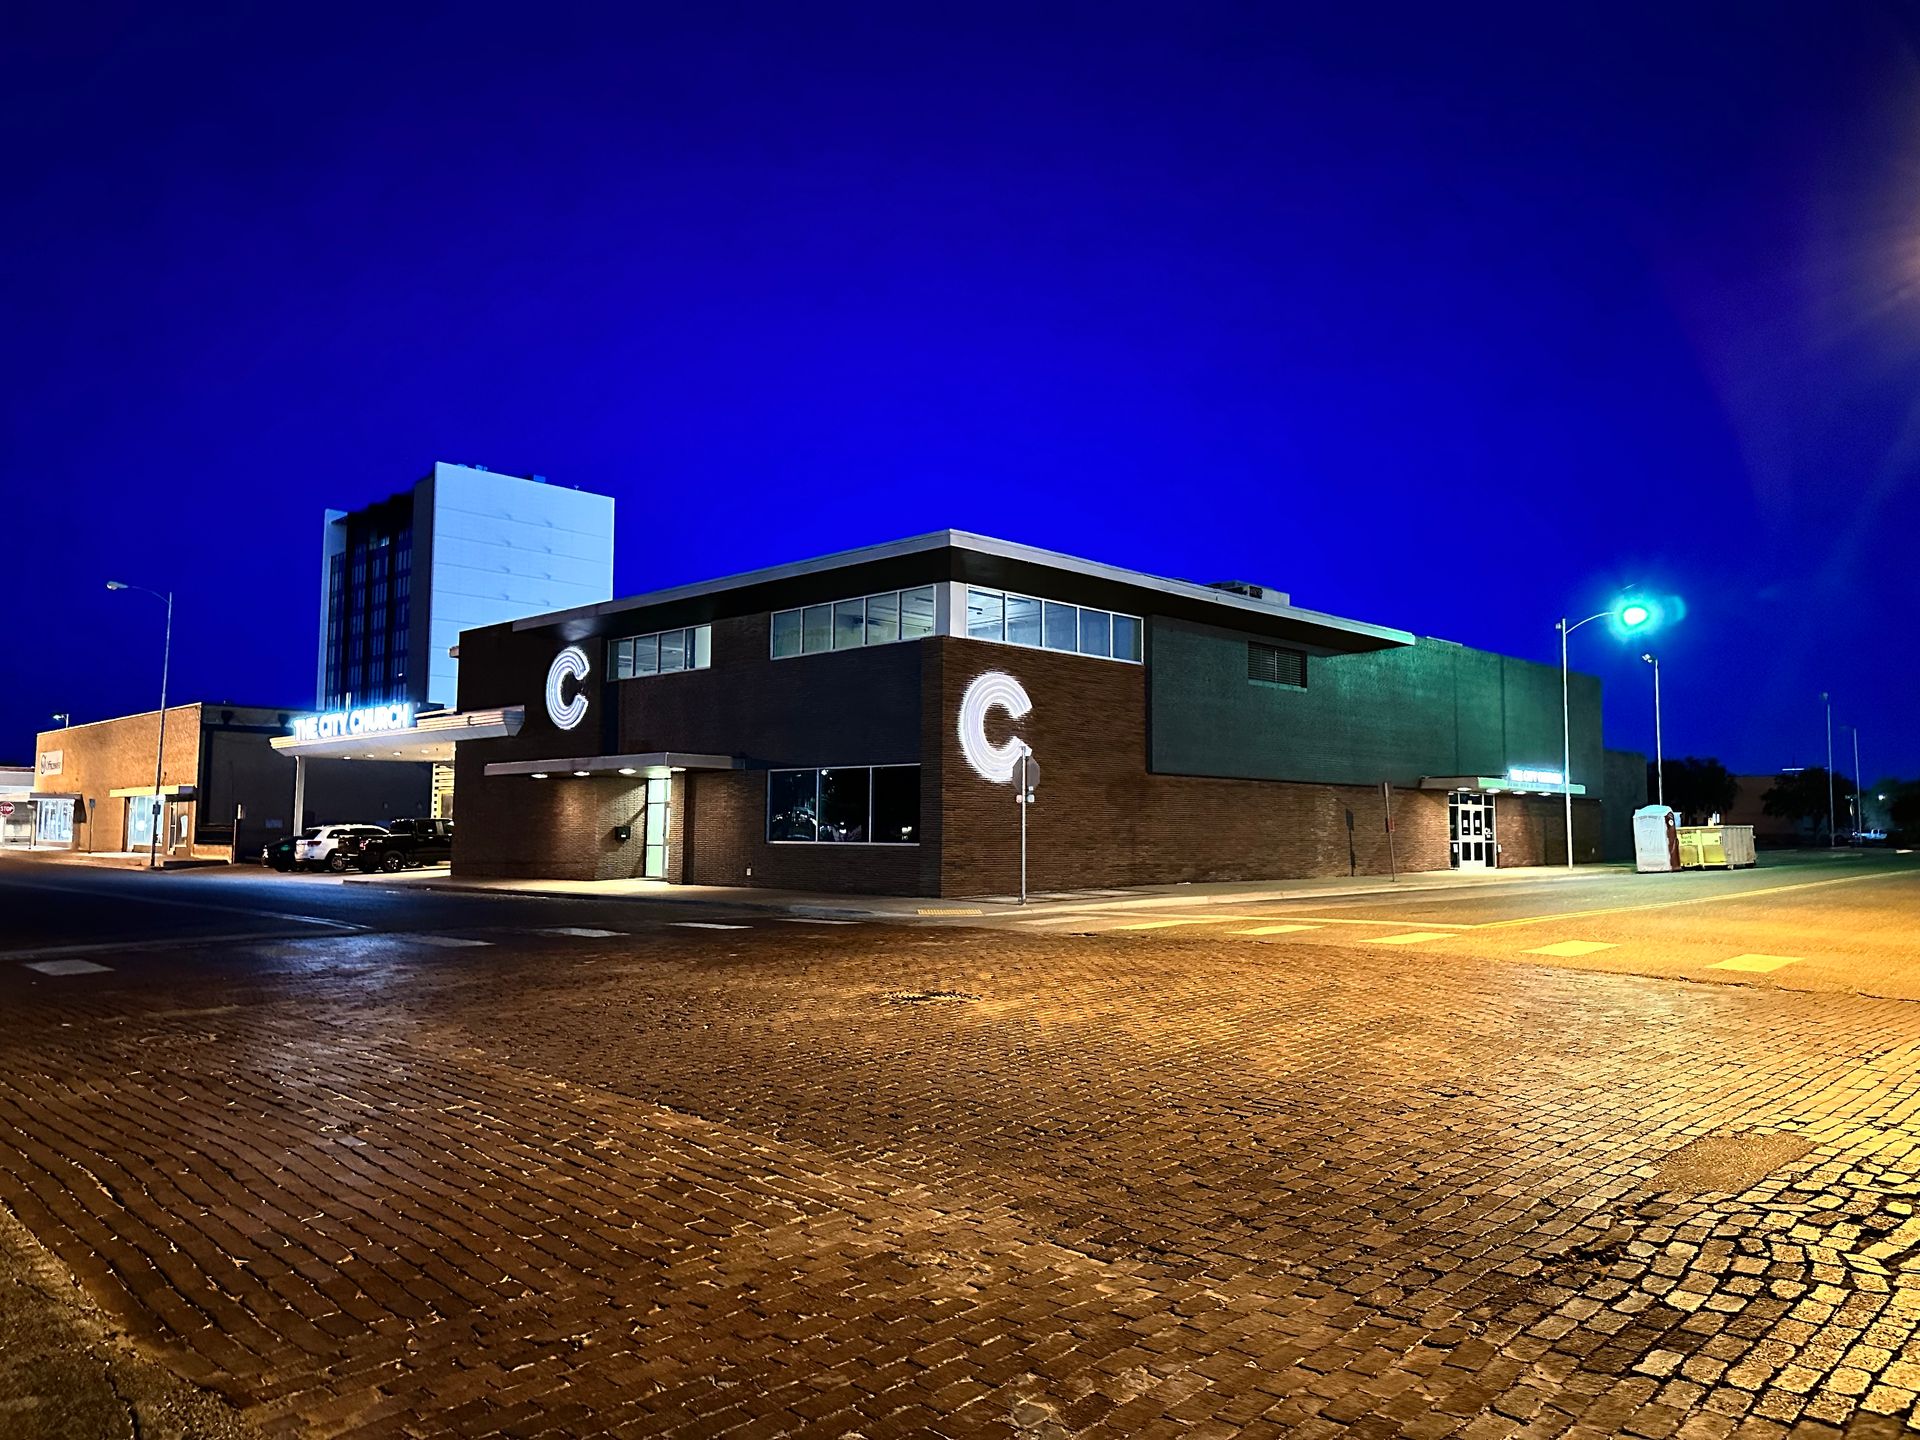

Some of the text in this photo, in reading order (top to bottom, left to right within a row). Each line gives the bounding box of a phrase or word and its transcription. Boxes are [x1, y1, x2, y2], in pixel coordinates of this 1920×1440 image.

[294, 703, 410, 740] THE CITY CHURCH
[546, 646, 590, 730] C
[958, 671, 1032, 783] C
